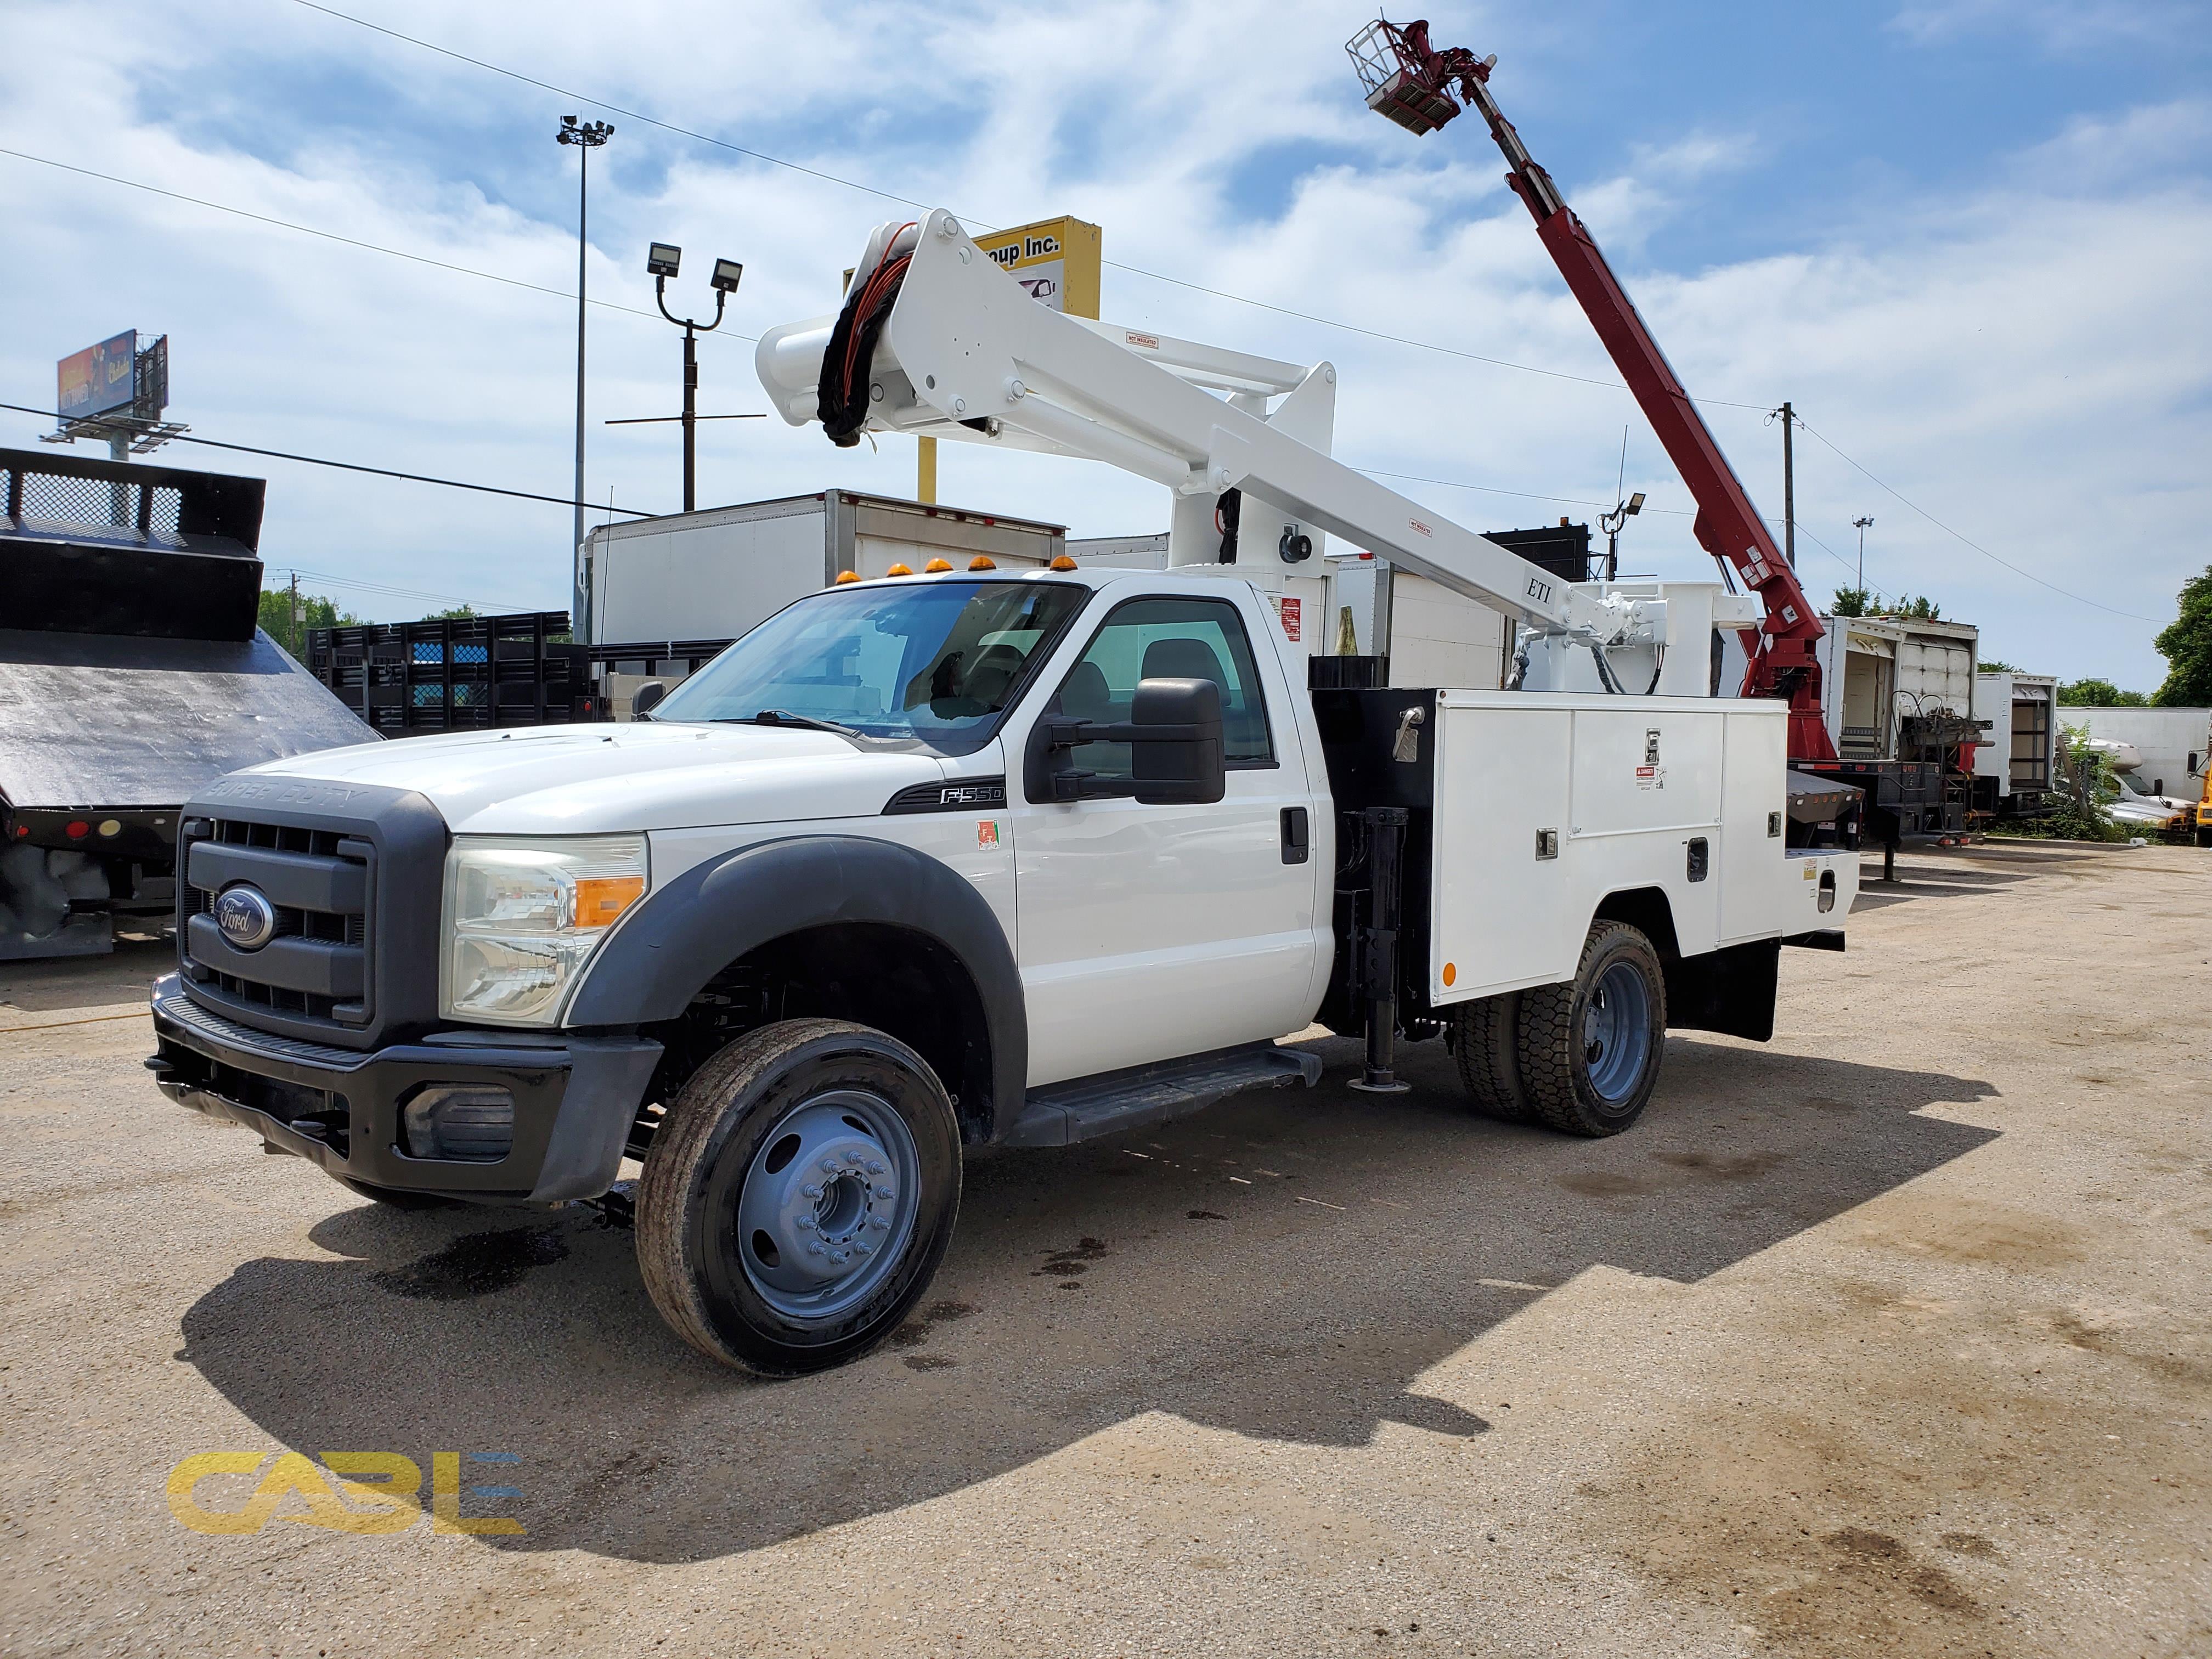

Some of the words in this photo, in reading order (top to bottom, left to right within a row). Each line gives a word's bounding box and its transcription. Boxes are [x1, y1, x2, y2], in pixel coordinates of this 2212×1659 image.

[985, 245, 1019, 266] oup
[1025, 237, 1059, 257] Inc.
[1417, 524, 1431, 534] INSULATED
[207, 781, 279, 800] SUPER
[276, 785, 369, 807] DUTY
[940, 787, 1005, 804] F-550
[221, 898, 251, 932] Ford
